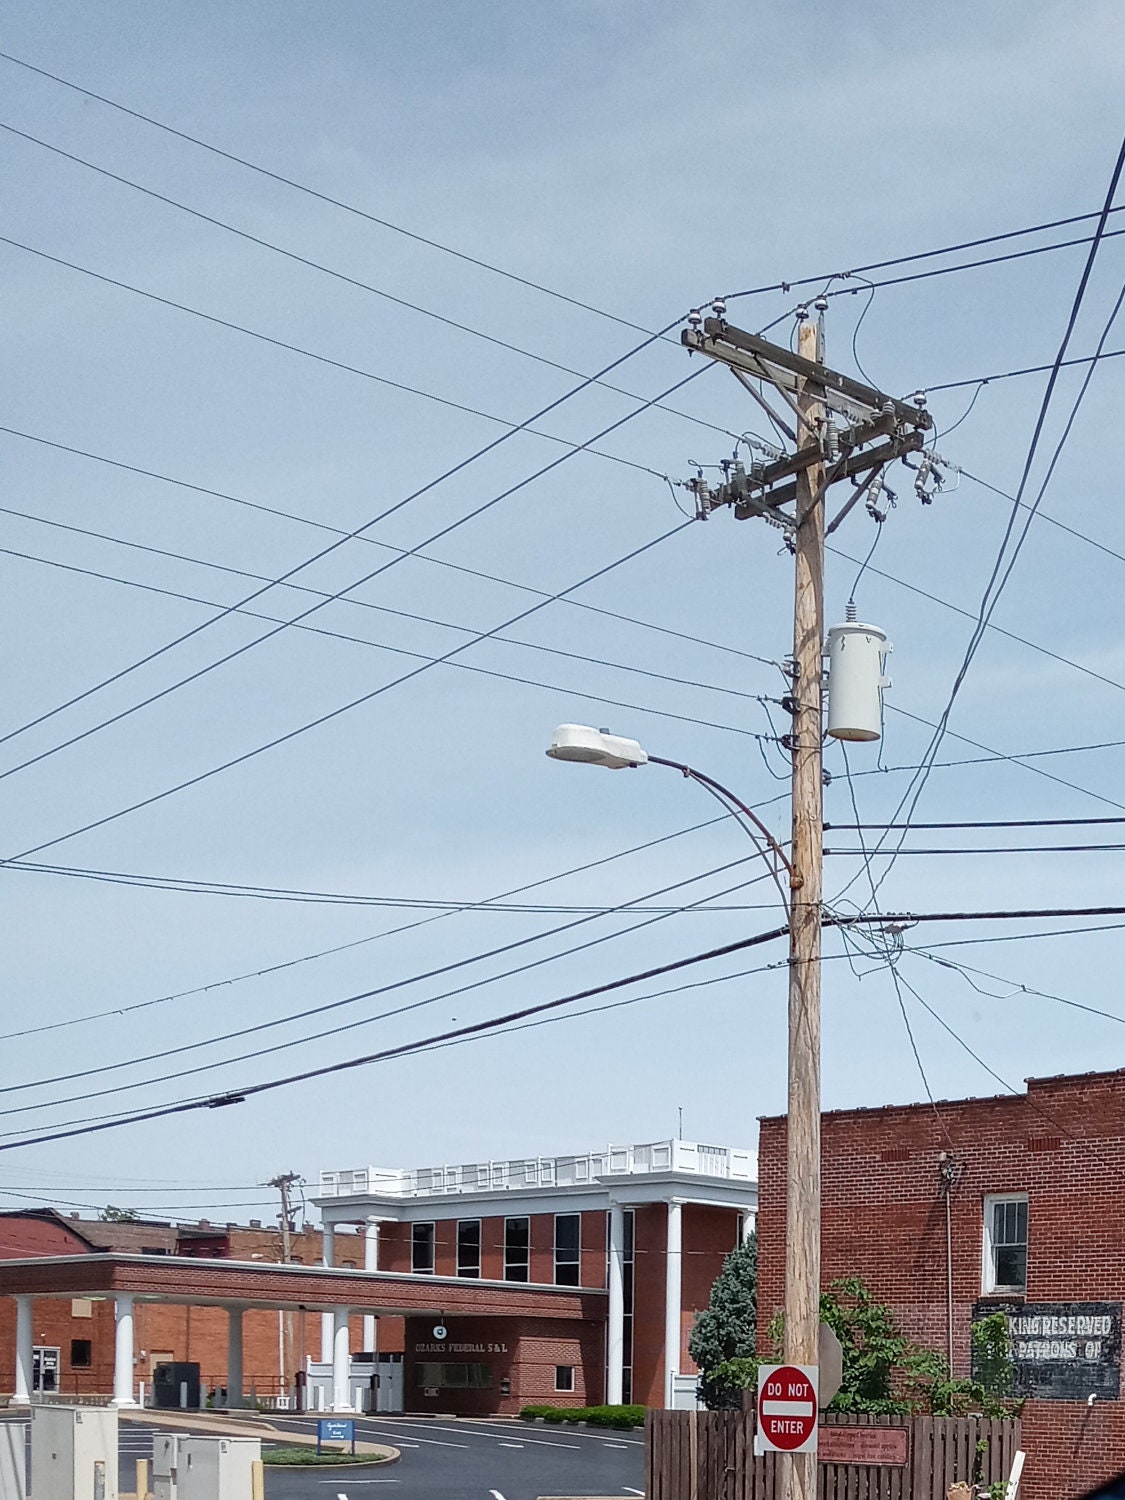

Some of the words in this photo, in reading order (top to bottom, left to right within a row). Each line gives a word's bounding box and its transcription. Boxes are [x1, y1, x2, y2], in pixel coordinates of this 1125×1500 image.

[1042, 1316, 1111, 1335] RESERVED
[415, 1343, 446, 1352] OZARKS
[448, 1343, 486, 1352] FEDERAL
[767, 1382, 782, 1396] DO
[788, 1383, 809, 1397] NOT
[771, 1420, 804, 1434] ENTER
